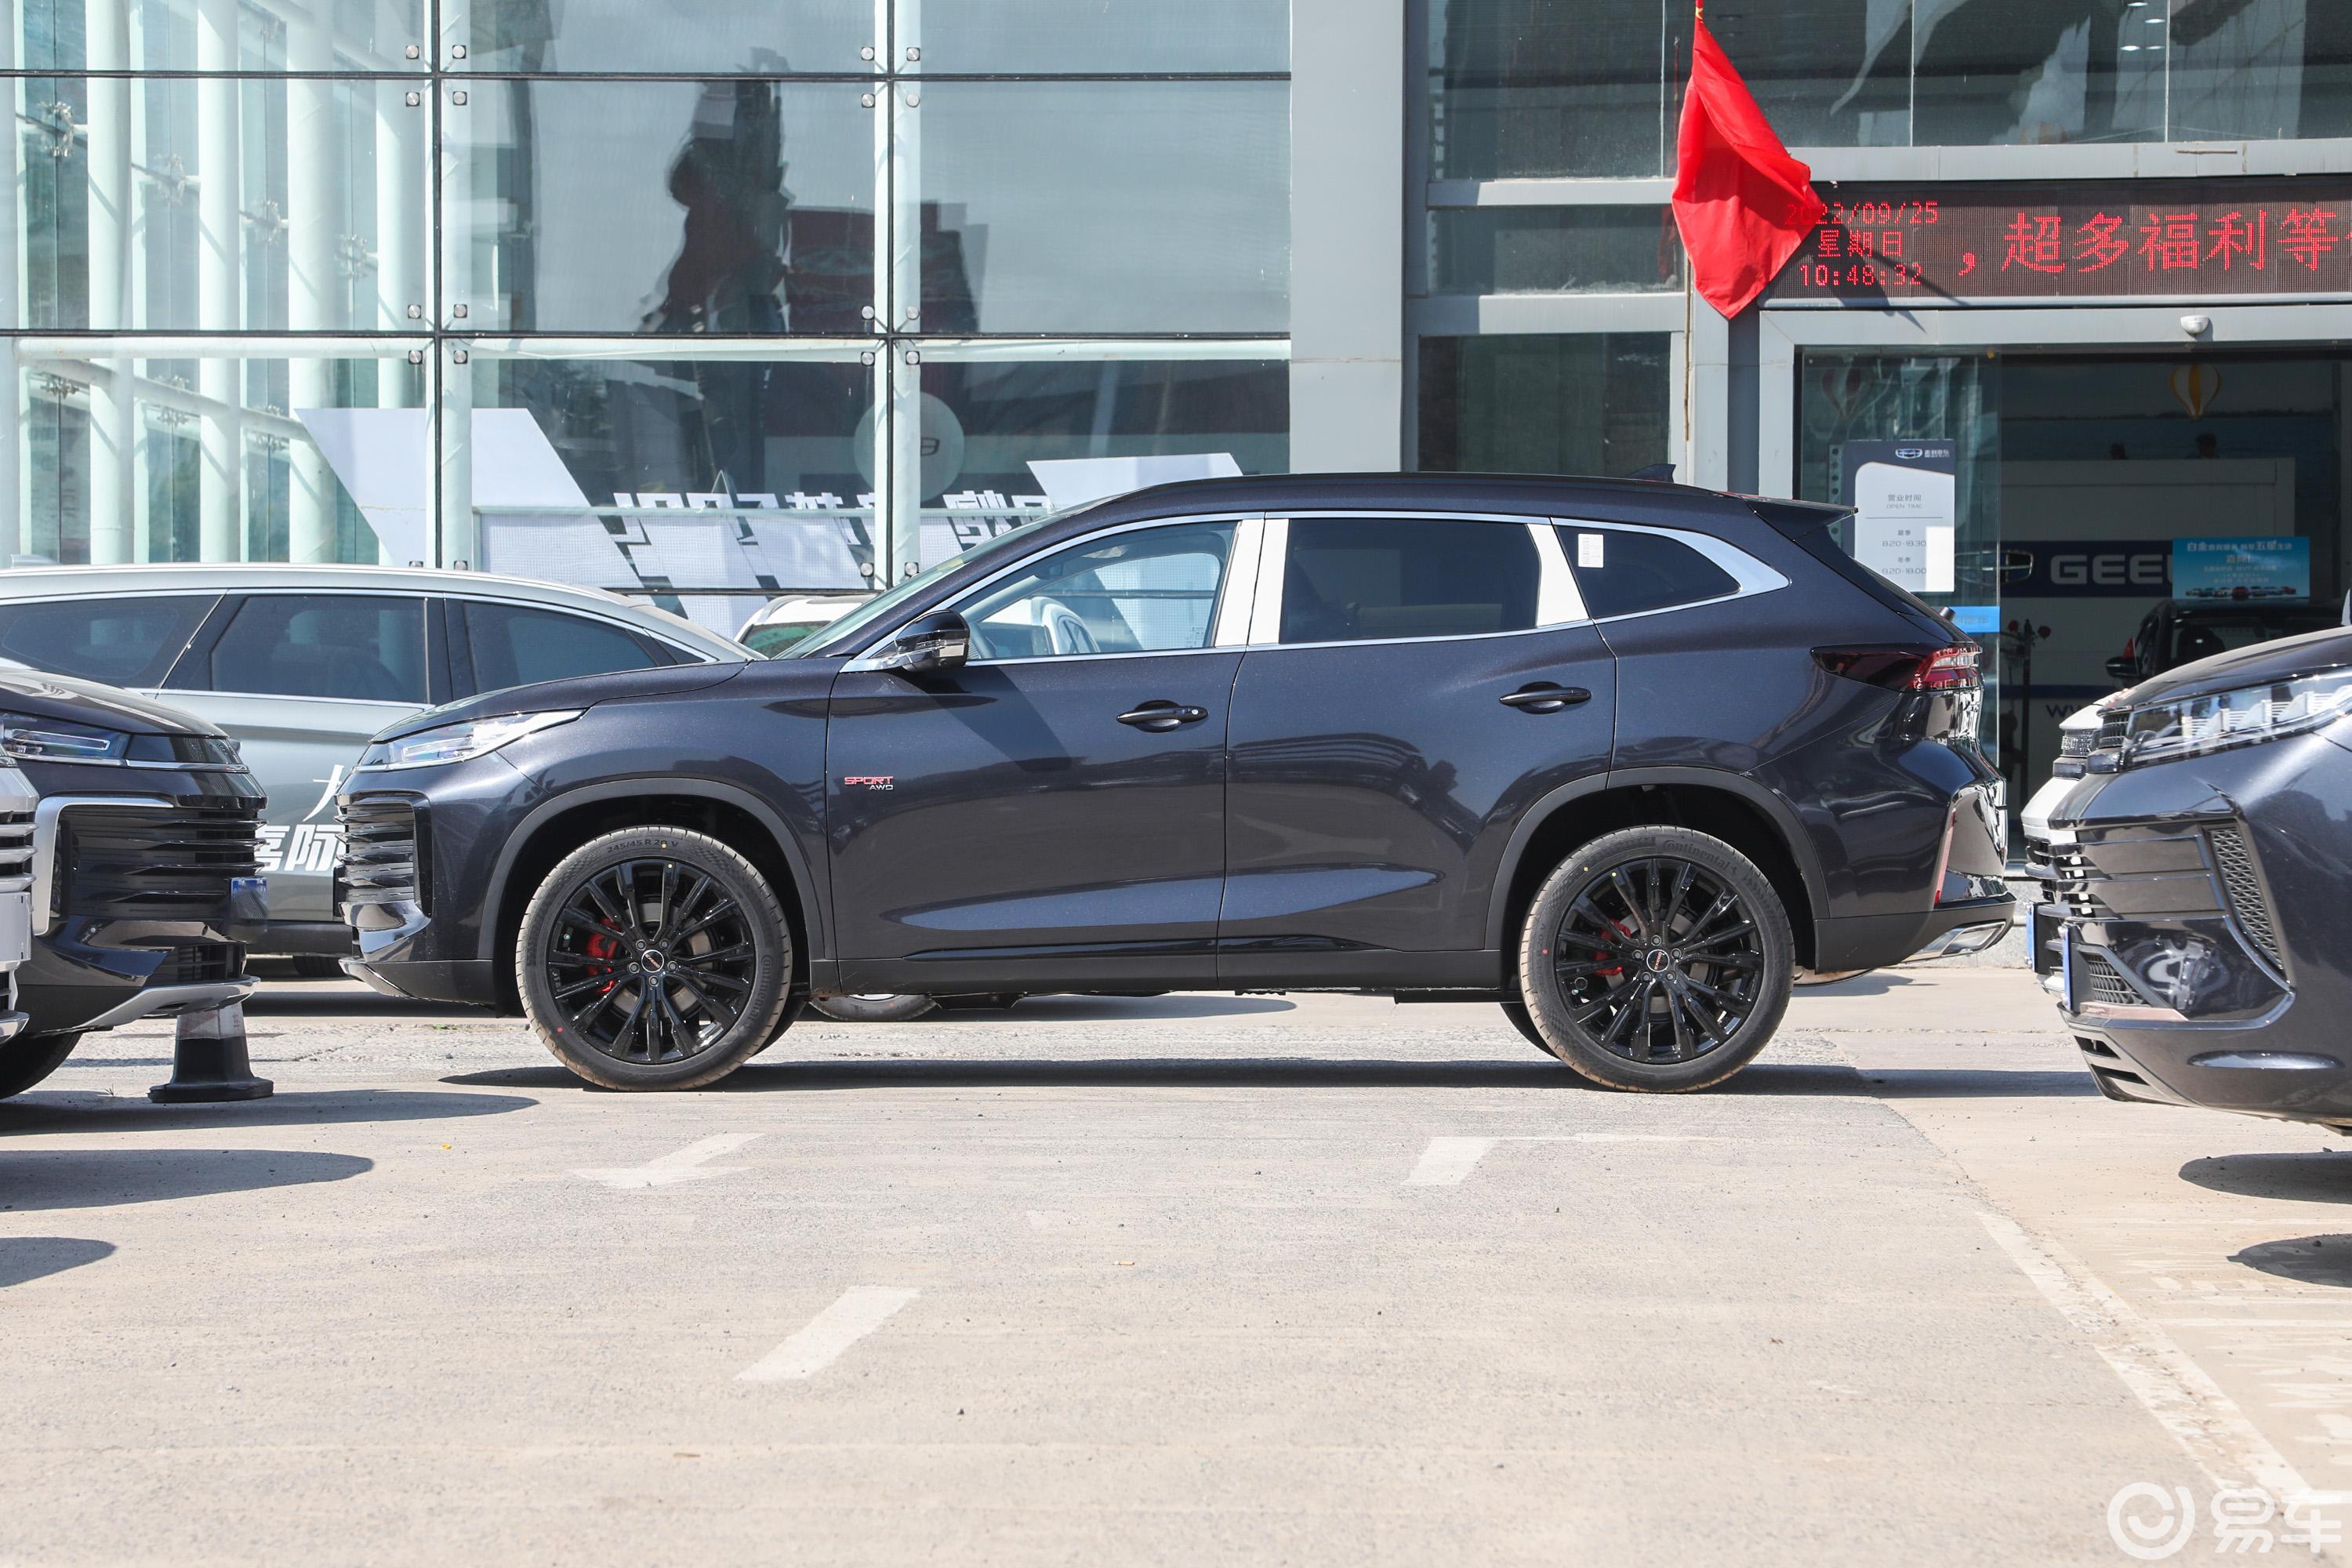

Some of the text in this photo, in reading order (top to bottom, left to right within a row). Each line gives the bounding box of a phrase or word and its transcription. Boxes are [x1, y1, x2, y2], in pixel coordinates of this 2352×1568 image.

[1818, 230, 1903, 257] 星期日
[1958, 209, 2352, 276] ，超多福利等
[1800, 263, 1922, 286] 10:48:32
[844, 776, 893, 785] SPORT
[607, 840, 642, 853] 245/45
[1663, 840, 1730, 870] Continental
